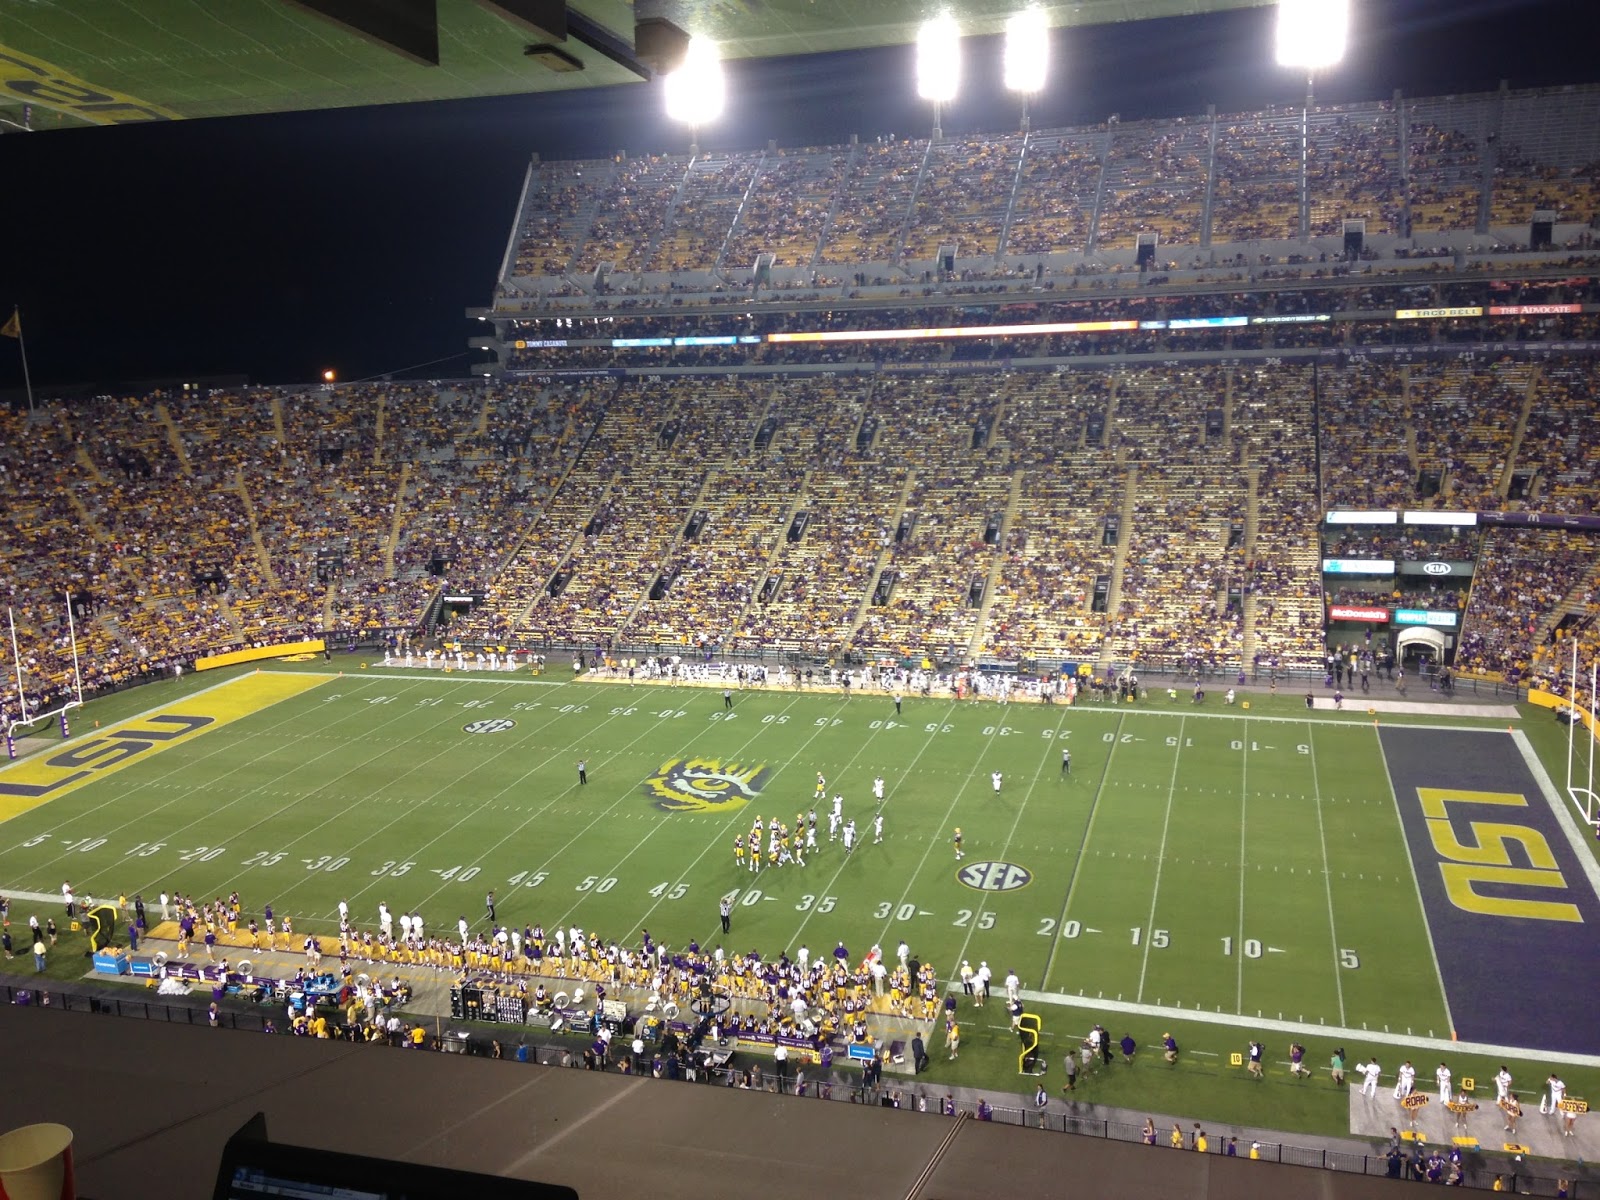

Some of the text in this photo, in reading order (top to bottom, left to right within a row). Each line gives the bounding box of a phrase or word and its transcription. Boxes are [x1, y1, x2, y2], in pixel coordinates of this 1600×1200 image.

[1521, 305, 1571, 314] ADVOCATE
[1265, 357, 1282, 366] 306
[1331, 609, 1387, 619] McDonald's
[465, 719, 514, 734] SEC
[0, 715, 215, 797] LSU
[23, 834, 52, 848] 5
[67, 837, 108, 852] 10
[125, 842, 168, 857] 15
[182, 846, 226, 861] 20
[240, 851, 290, 867] 25
[1415, 787, 1585, 923] LSU
[307, 856, 350, 872] 30
[371, 860, 417, 878] 35
[439, 865, 482, 882] 40
[507, 870, 550, 888] 45
[963, 861, 1029, 891] SEC
[575, 875, 619, 894] 50
[648, 881, 691, 900] 45
[721, 888, 764, 907] 40
[795, 894, 838, 914] 35
[873, 902, 917, 922] 30
[952, 909, 997, 930] 25
[1037, 917, 1082, 939] 20
[1130, 926, 1171, 948] 15
[1221, 936, 1262, 959] 10
[1339, 948, 1360, 970] 5
[1232, 1054, 1241, 1063] 10
[1465, 1079, 1472, 1088] G
[1405, 1096, 1426, 1107] ROAR
[1562, 1102, 1588, 1113] DEFENSE
